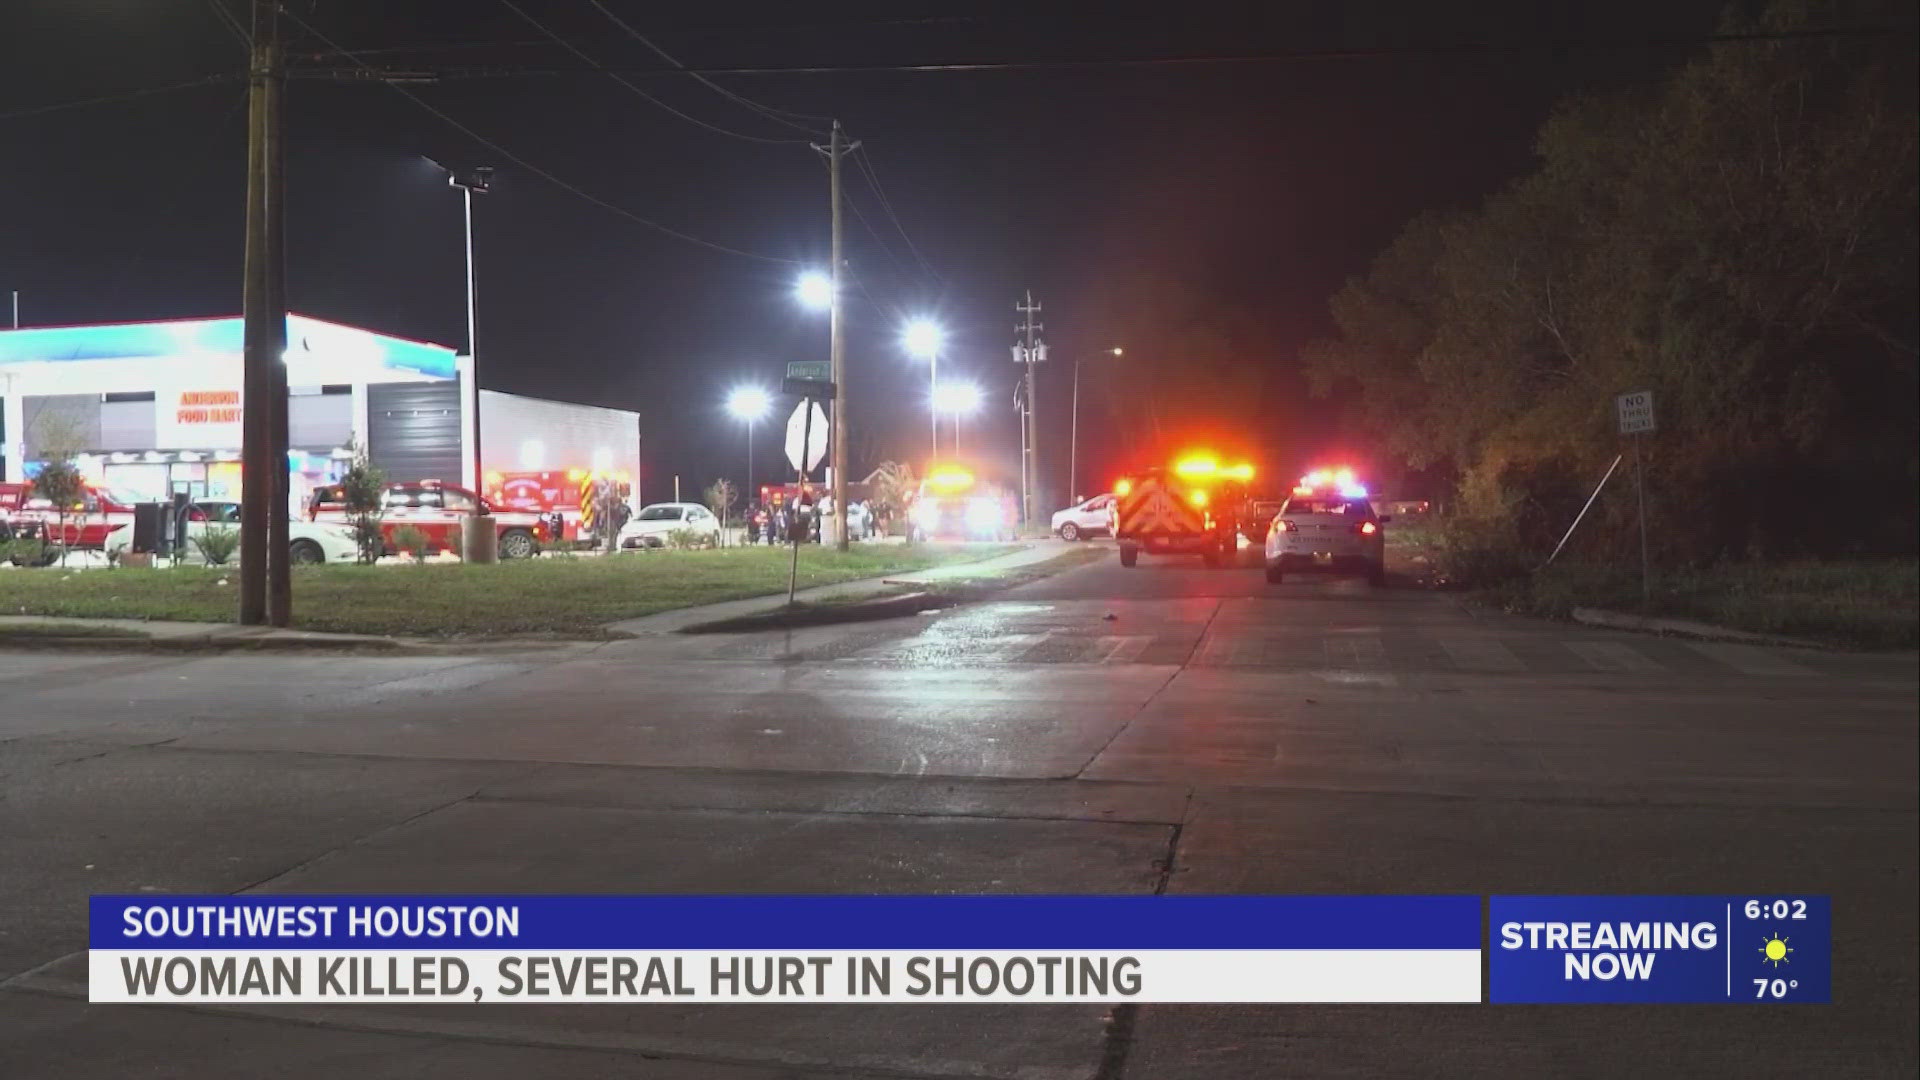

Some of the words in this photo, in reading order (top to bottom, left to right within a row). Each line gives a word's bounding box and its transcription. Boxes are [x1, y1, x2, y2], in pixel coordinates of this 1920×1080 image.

[1625, 395, 1644, 408] NO
[177, 409, 208, 424] FOOD
[209, 408, 242, 423] MART
[1623, 408, 1649, 419] THRU
